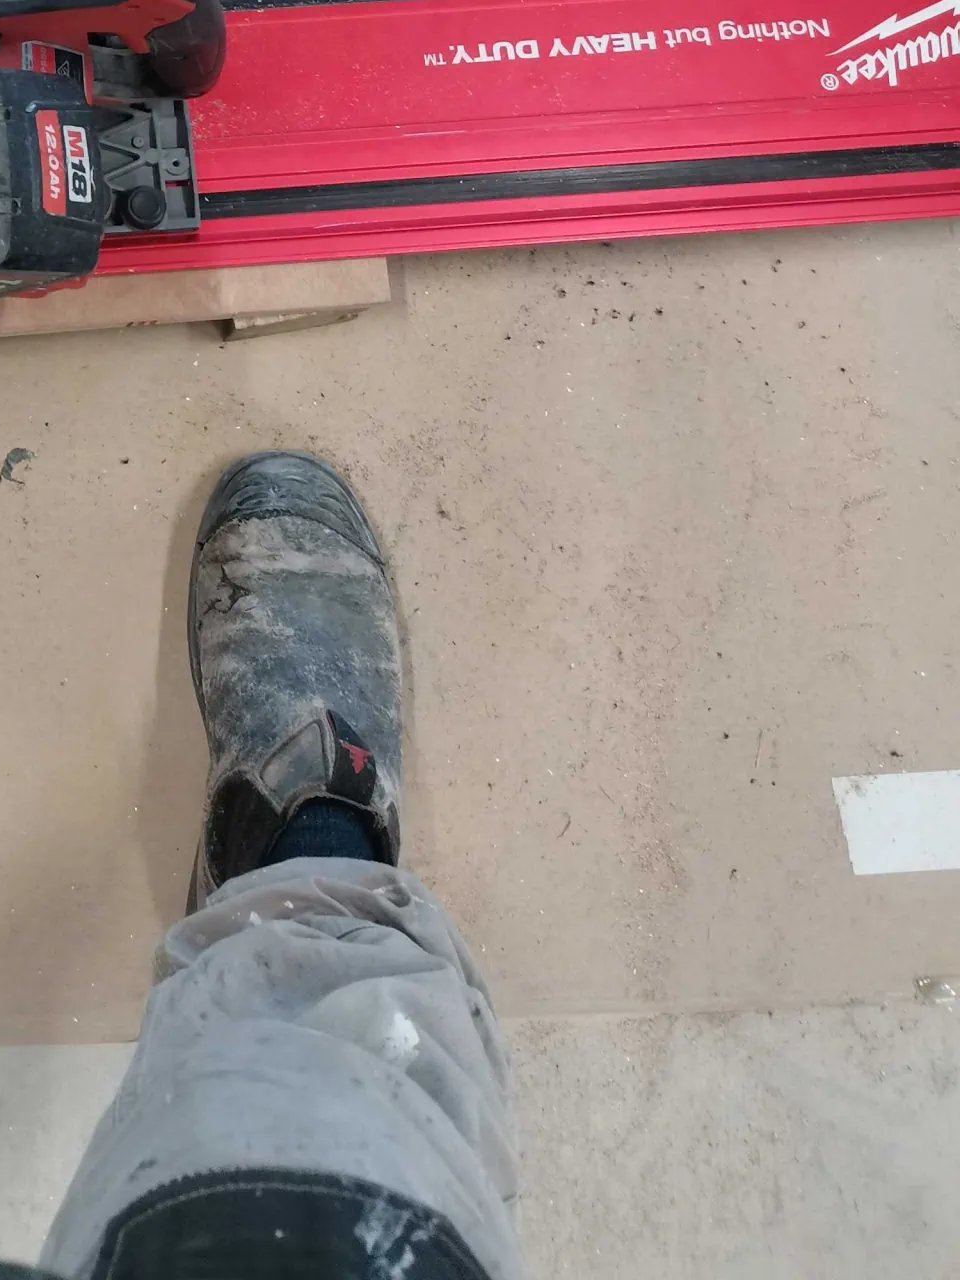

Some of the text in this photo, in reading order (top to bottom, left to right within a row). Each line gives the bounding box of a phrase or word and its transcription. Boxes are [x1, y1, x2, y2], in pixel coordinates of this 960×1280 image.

[664, 26, 712, 48] but
[718, 17, 831, 43] Nothing
[548, 31, 657, 59] HEAVY
[44, 123, 61, 200] 12.0Ah
[67, 130, 88, 199] M18
